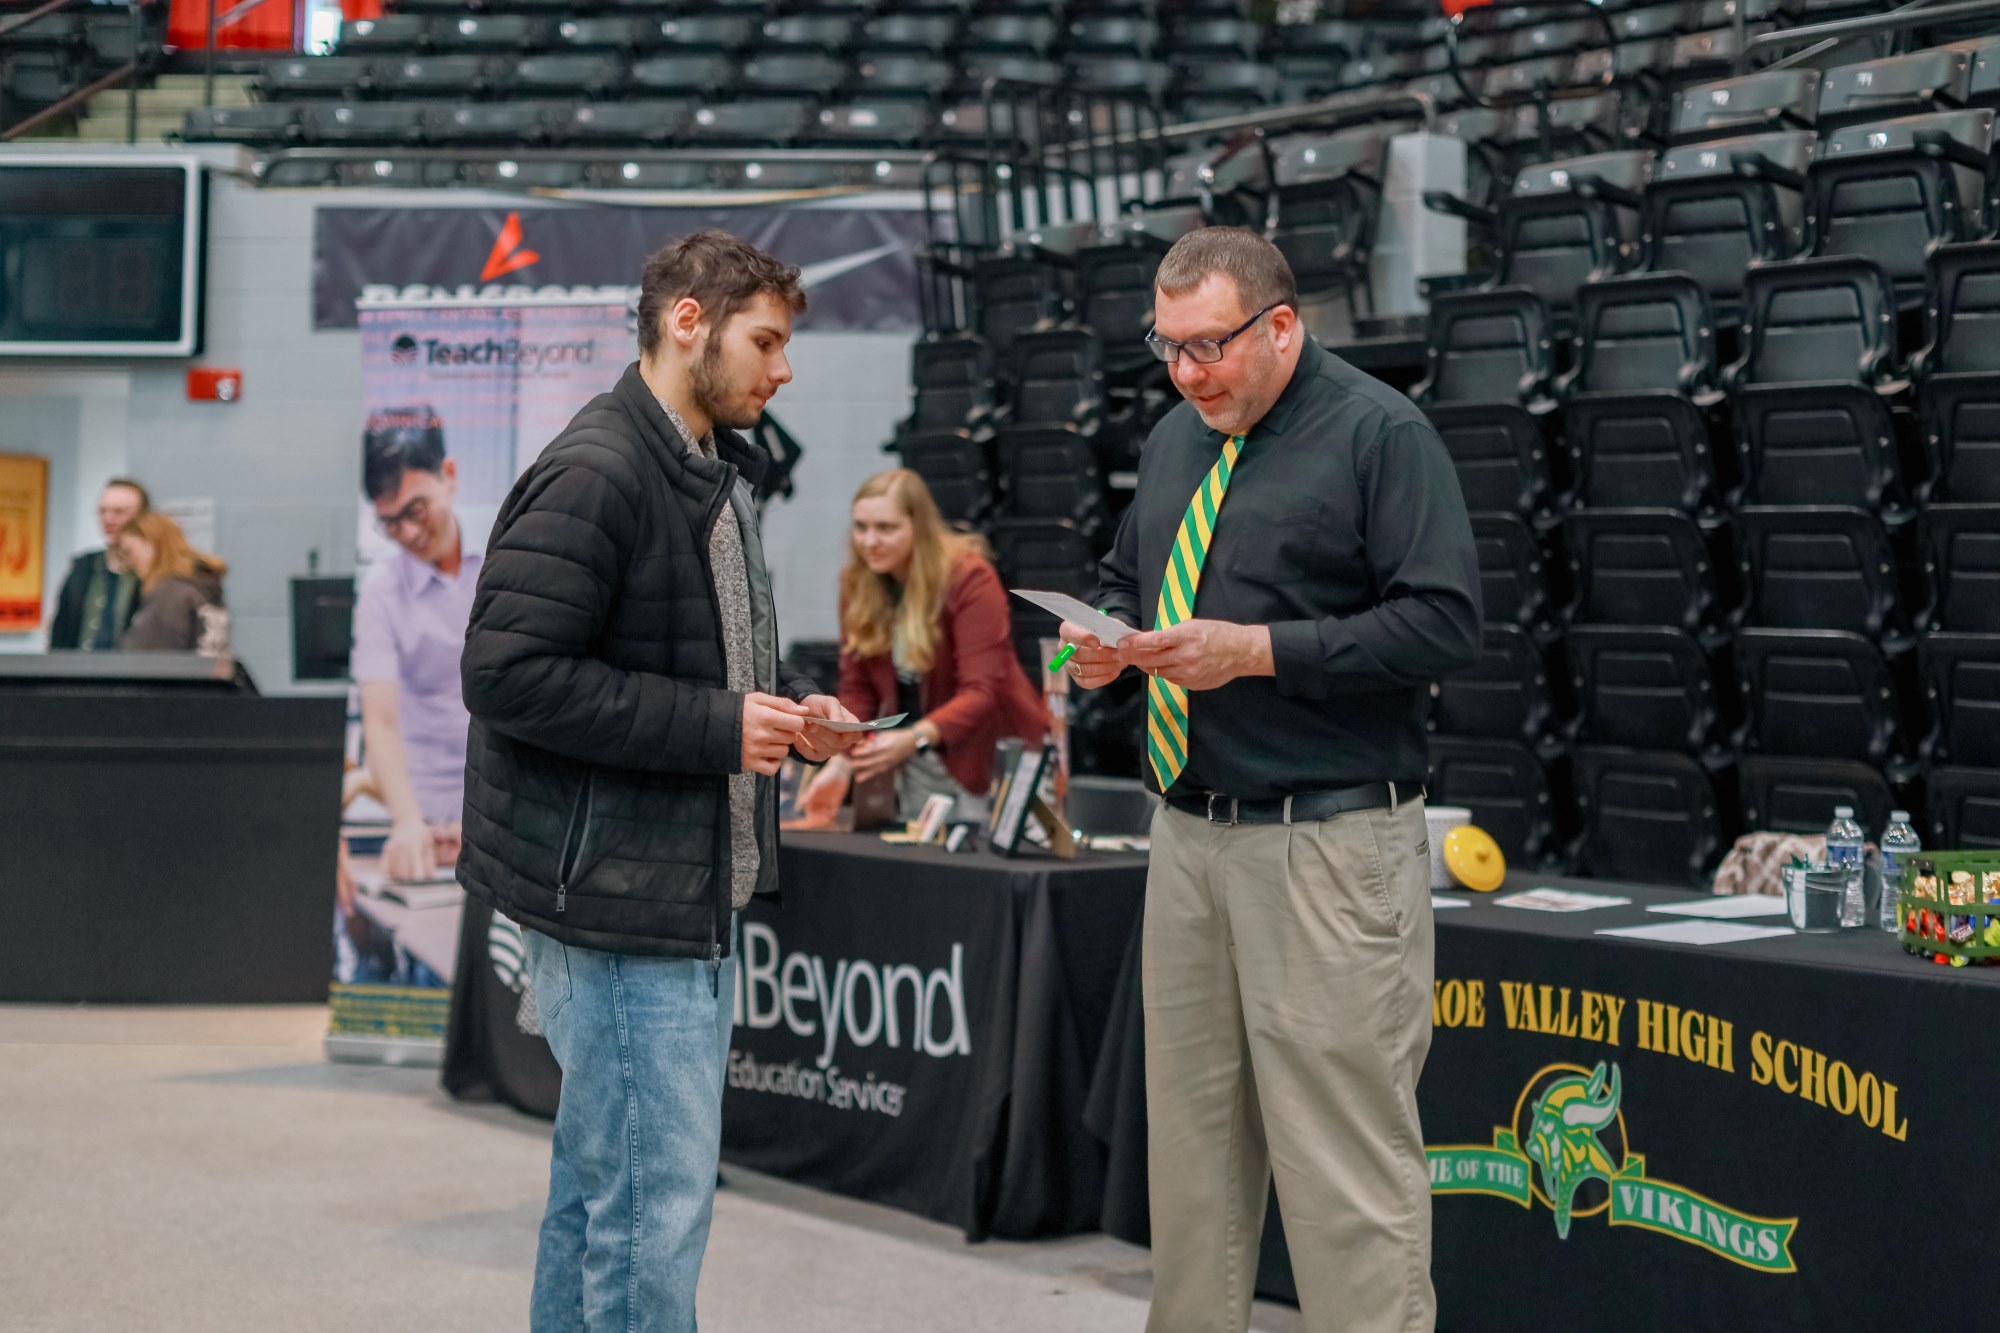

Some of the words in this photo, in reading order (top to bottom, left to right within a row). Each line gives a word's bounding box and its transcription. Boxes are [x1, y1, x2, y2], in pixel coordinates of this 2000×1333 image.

[424, 338, 594, 372] TeachBeyond
[727, 1050, 825, 1102] Education
[1500, 980, 1626, 1046] VALLEY
[1637, 998, 1735, 1073] HIGH
[1751, 1030, 1908, 1142] SCHOOL
[1456, 1159, 1481, 1180] OF
[1484, 1161, 1524, 1189] THE
[1619, 1185, 1779, 1262] VIKINGS
